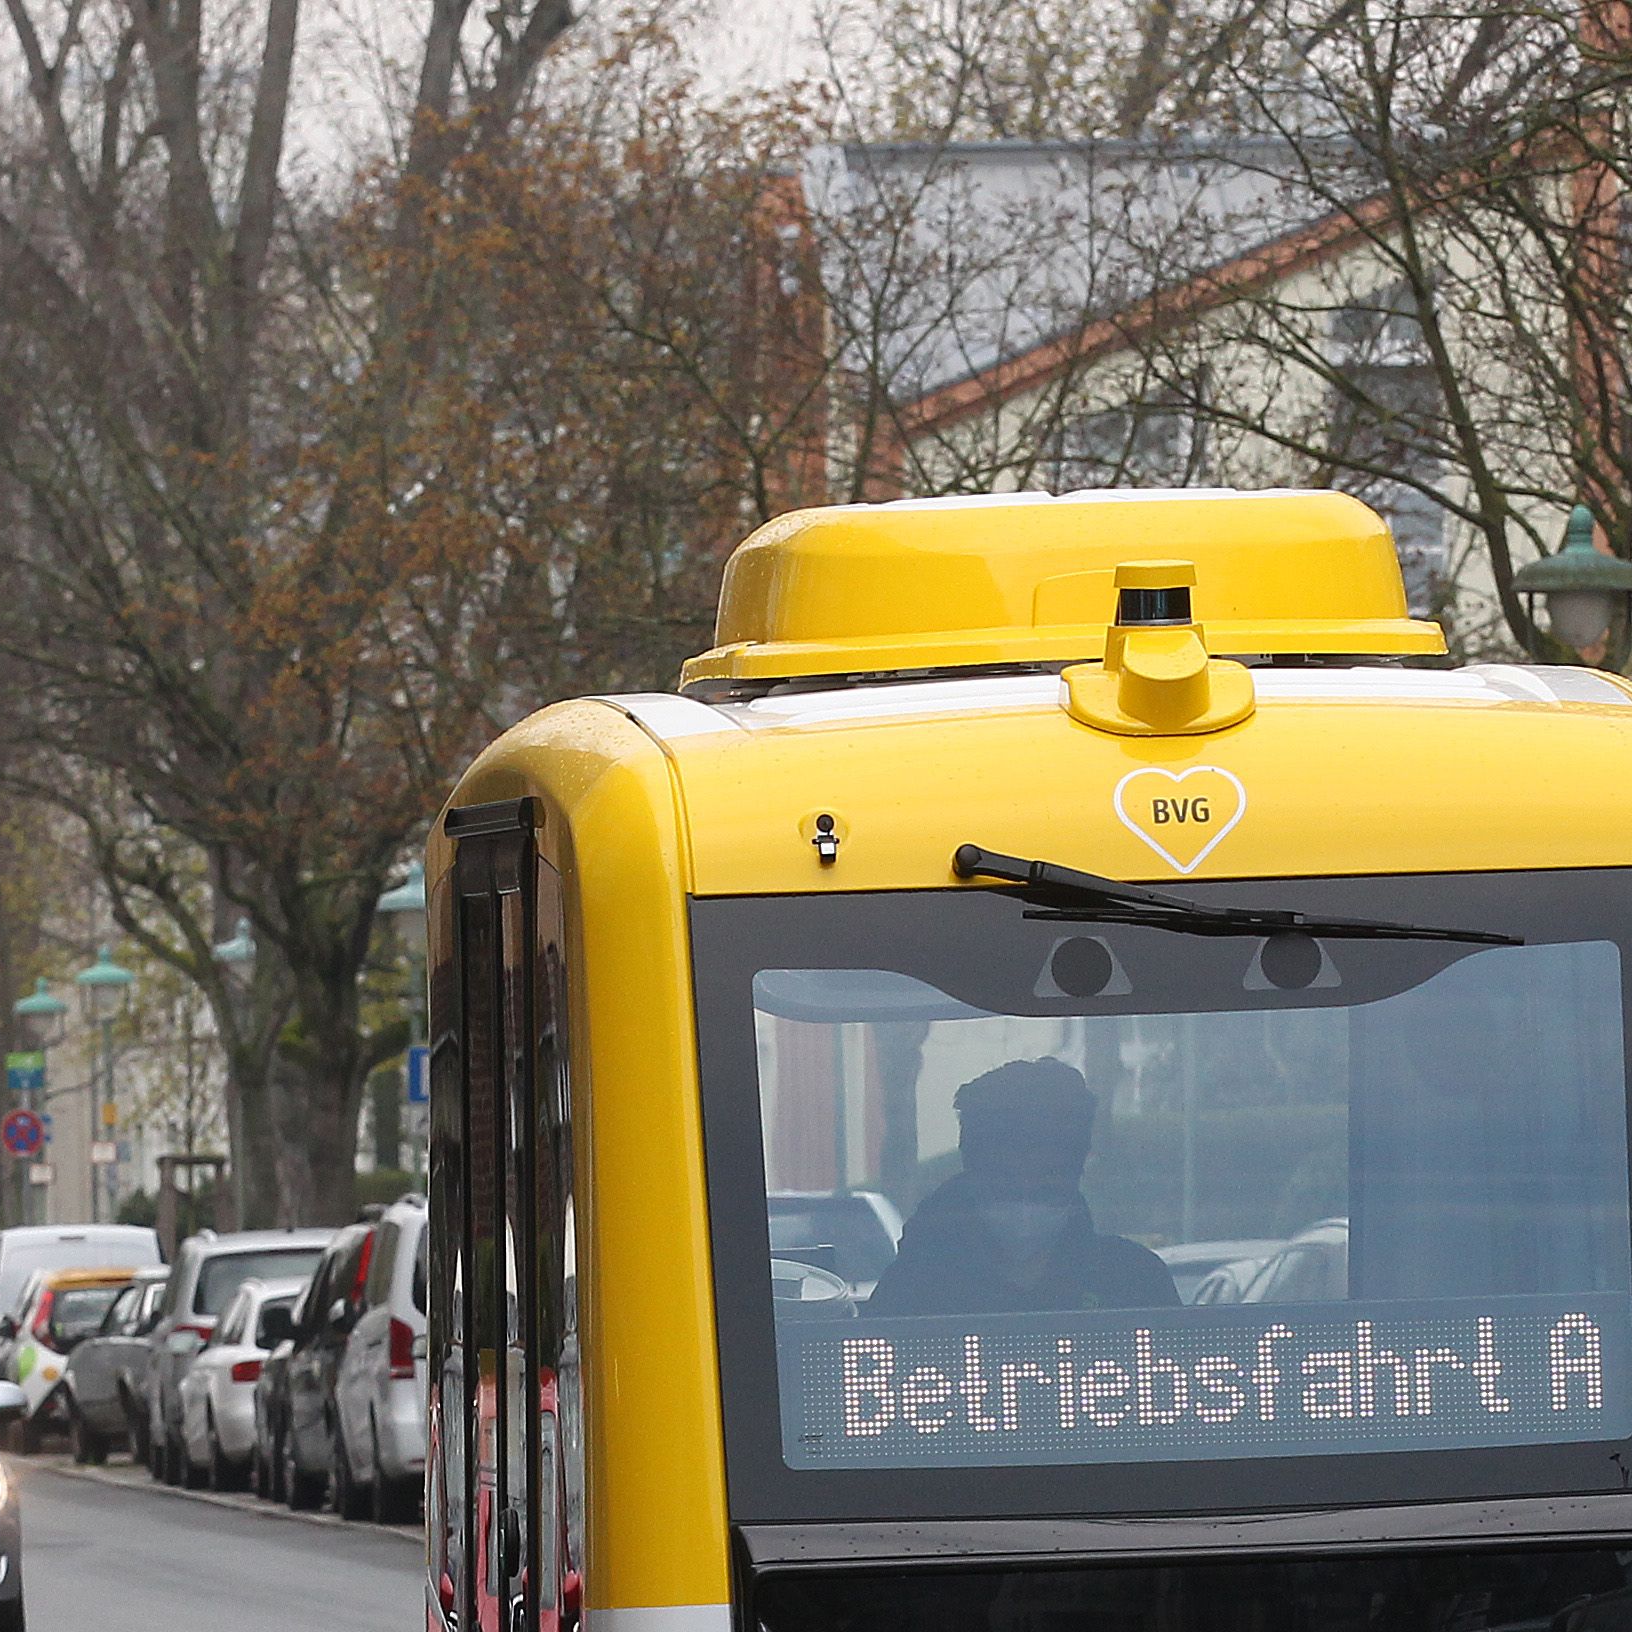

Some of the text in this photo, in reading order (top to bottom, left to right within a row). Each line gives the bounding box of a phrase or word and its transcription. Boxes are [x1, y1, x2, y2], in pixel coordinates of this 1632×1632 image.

[1152, 797, 1210, 824] BVG
[841, 1311, 1603, 1438] Betriebsfahrt A
